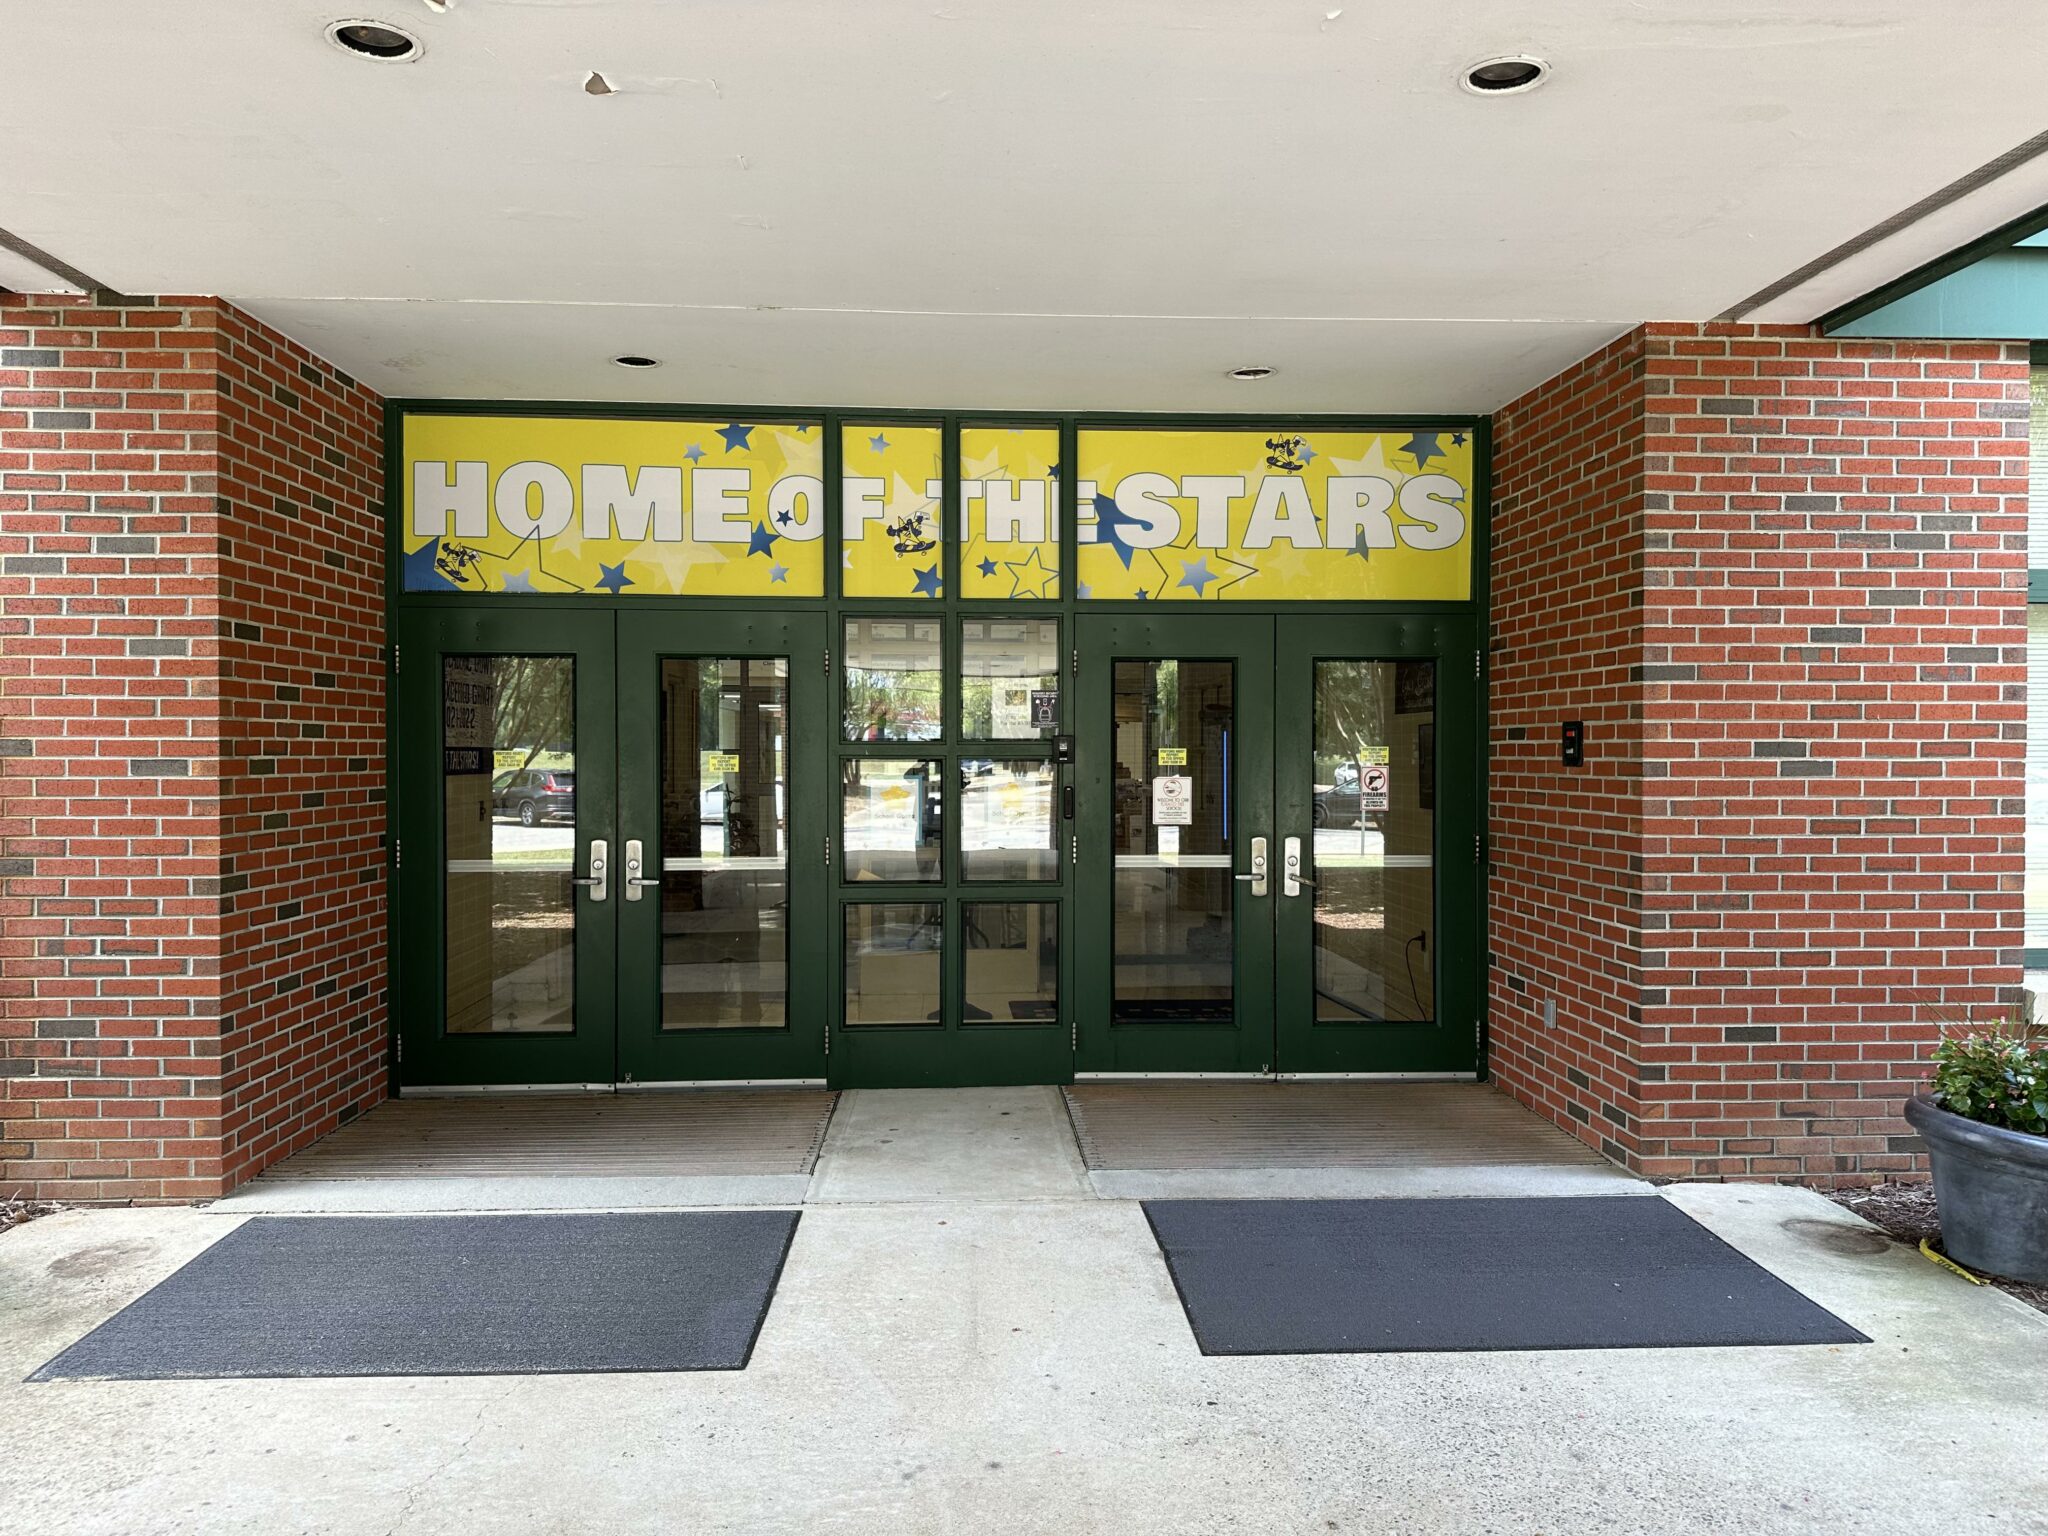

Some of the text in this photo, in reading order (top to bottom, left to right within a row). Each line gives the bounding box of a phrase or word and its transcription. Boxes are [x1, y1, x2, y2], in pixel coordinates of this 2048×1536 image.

[413, 461, 1467, 551] HOME OF THE STARS
